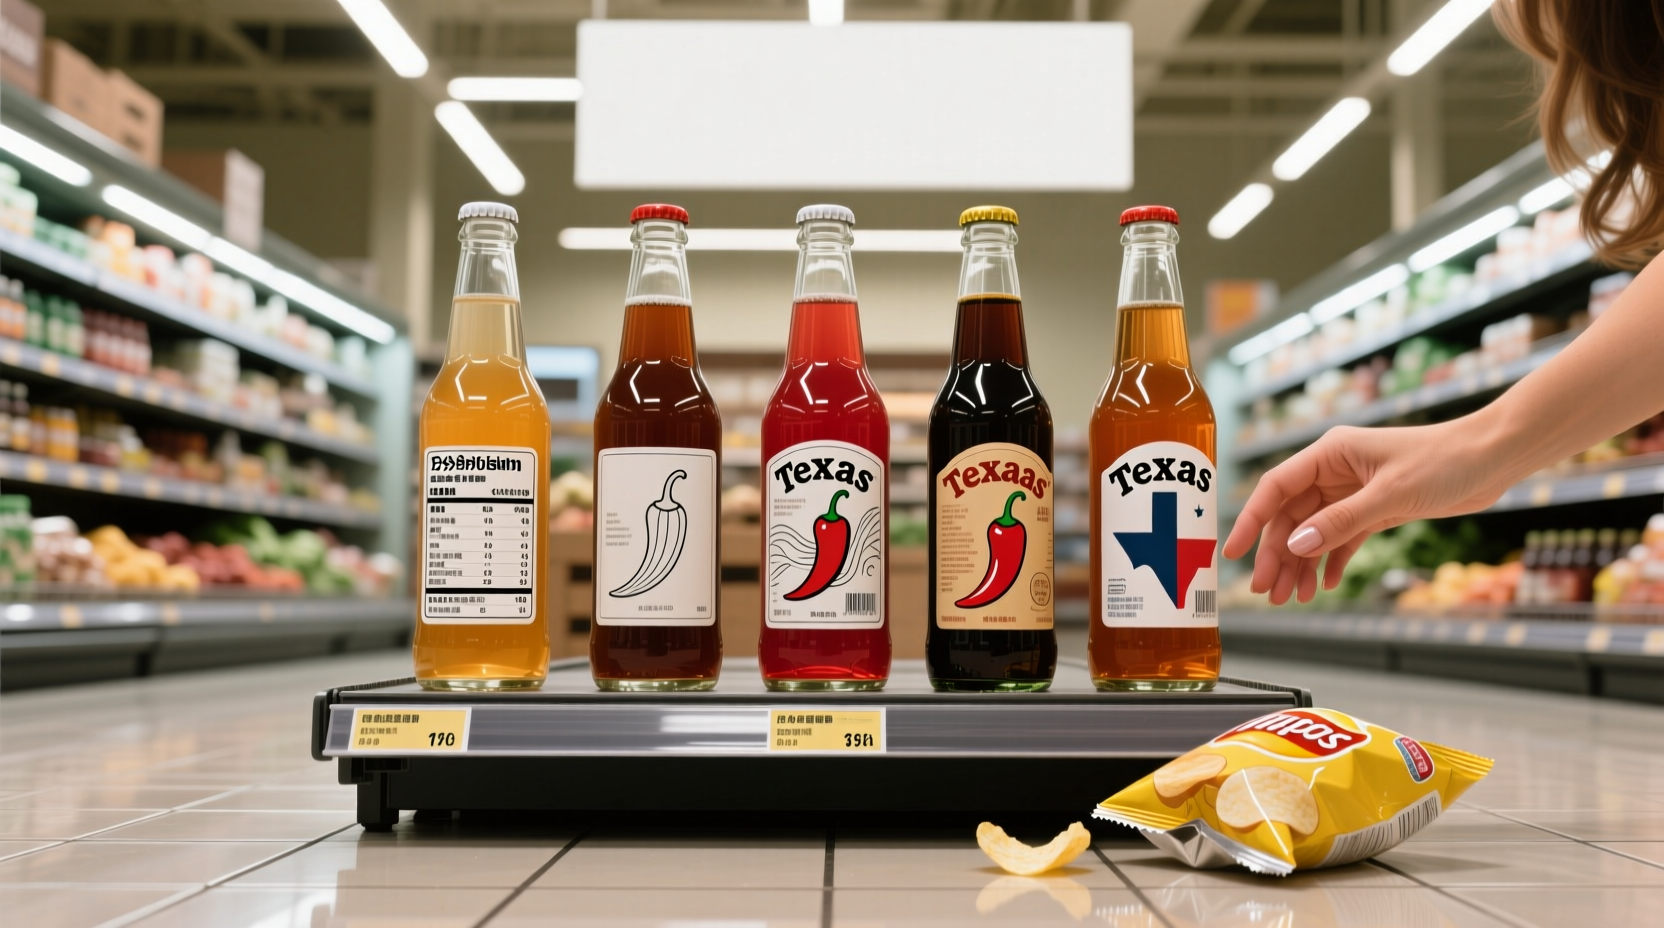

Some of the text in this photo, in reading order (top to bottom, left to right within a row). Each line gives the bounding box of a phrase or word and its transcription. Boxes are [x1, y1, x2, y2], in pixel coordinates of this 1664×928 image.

[774, 458, 874, 494] Texas
[942, 460, 1047, 499] Texaas
[1108, 457, 1212, 497] Texas
